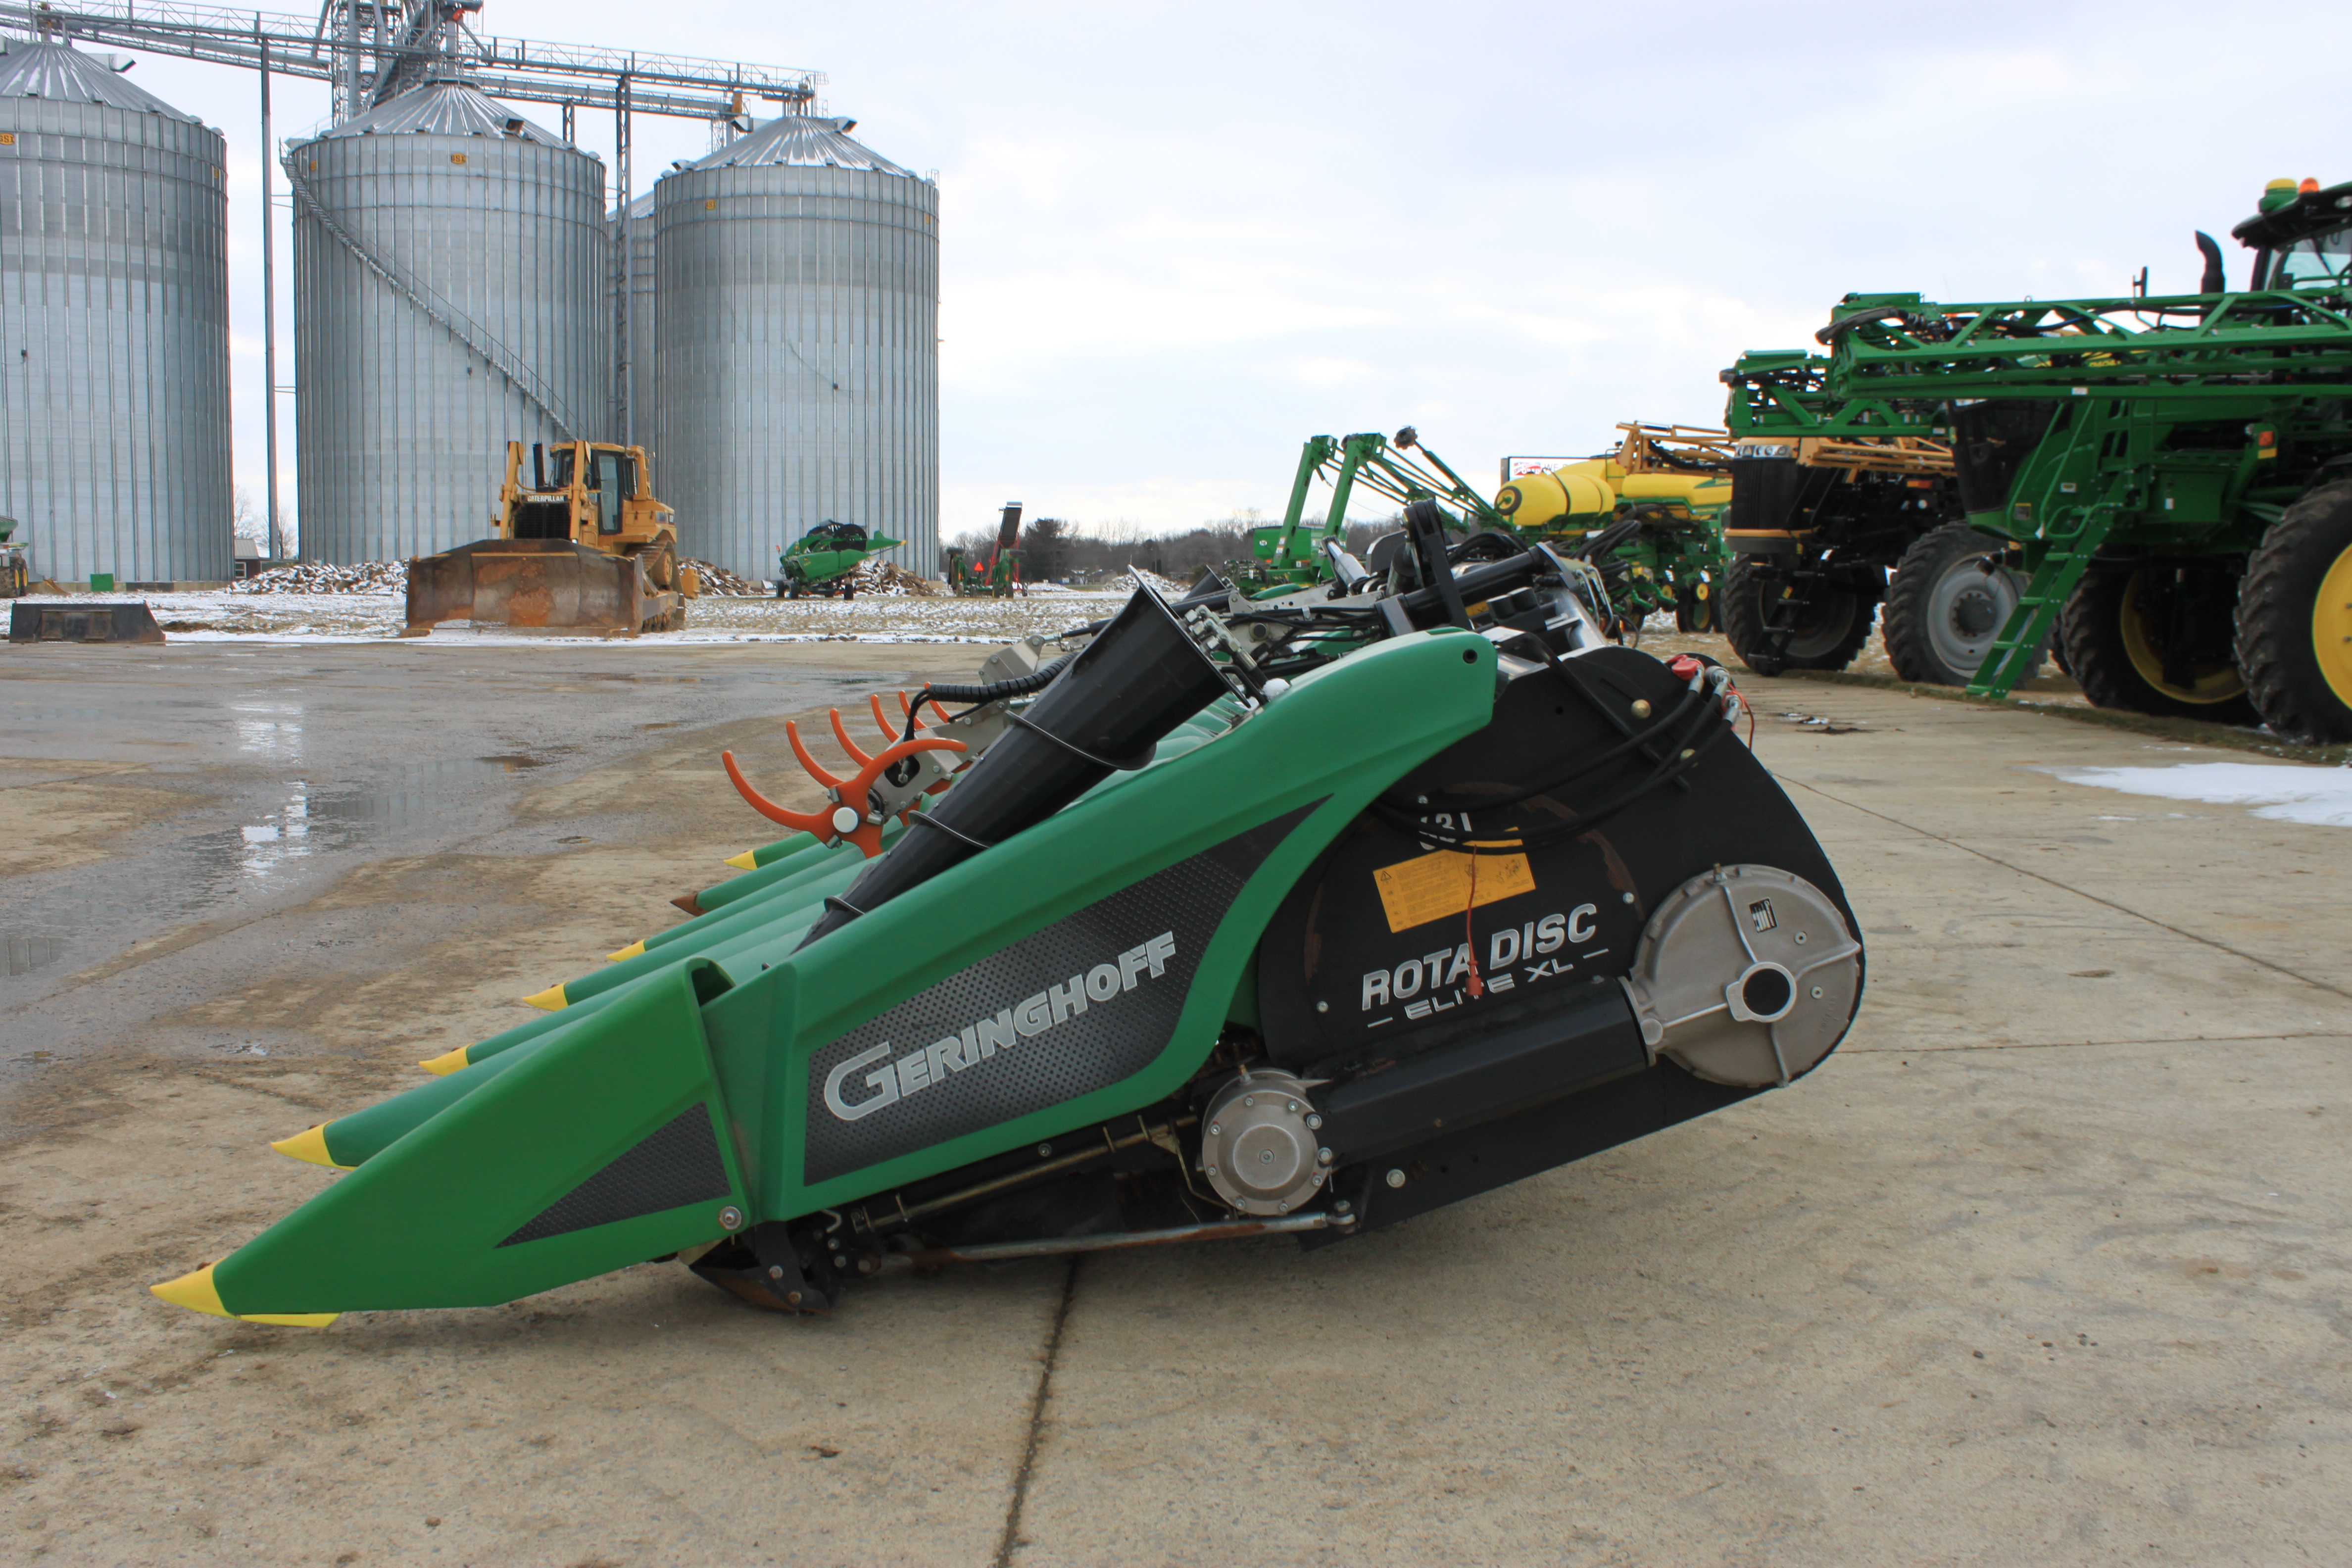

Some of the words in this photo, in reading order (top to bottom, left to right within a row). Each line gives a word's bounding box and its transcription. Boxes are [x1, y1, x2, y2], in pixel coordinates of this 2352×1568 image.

[1362, 942, 1478, 1011] ROTA
[1490, 903, 1597, 970] DISC
[1524, 959, 1574, 983] XL
[824, 931, 1176, 1121] GERINGHOFF
